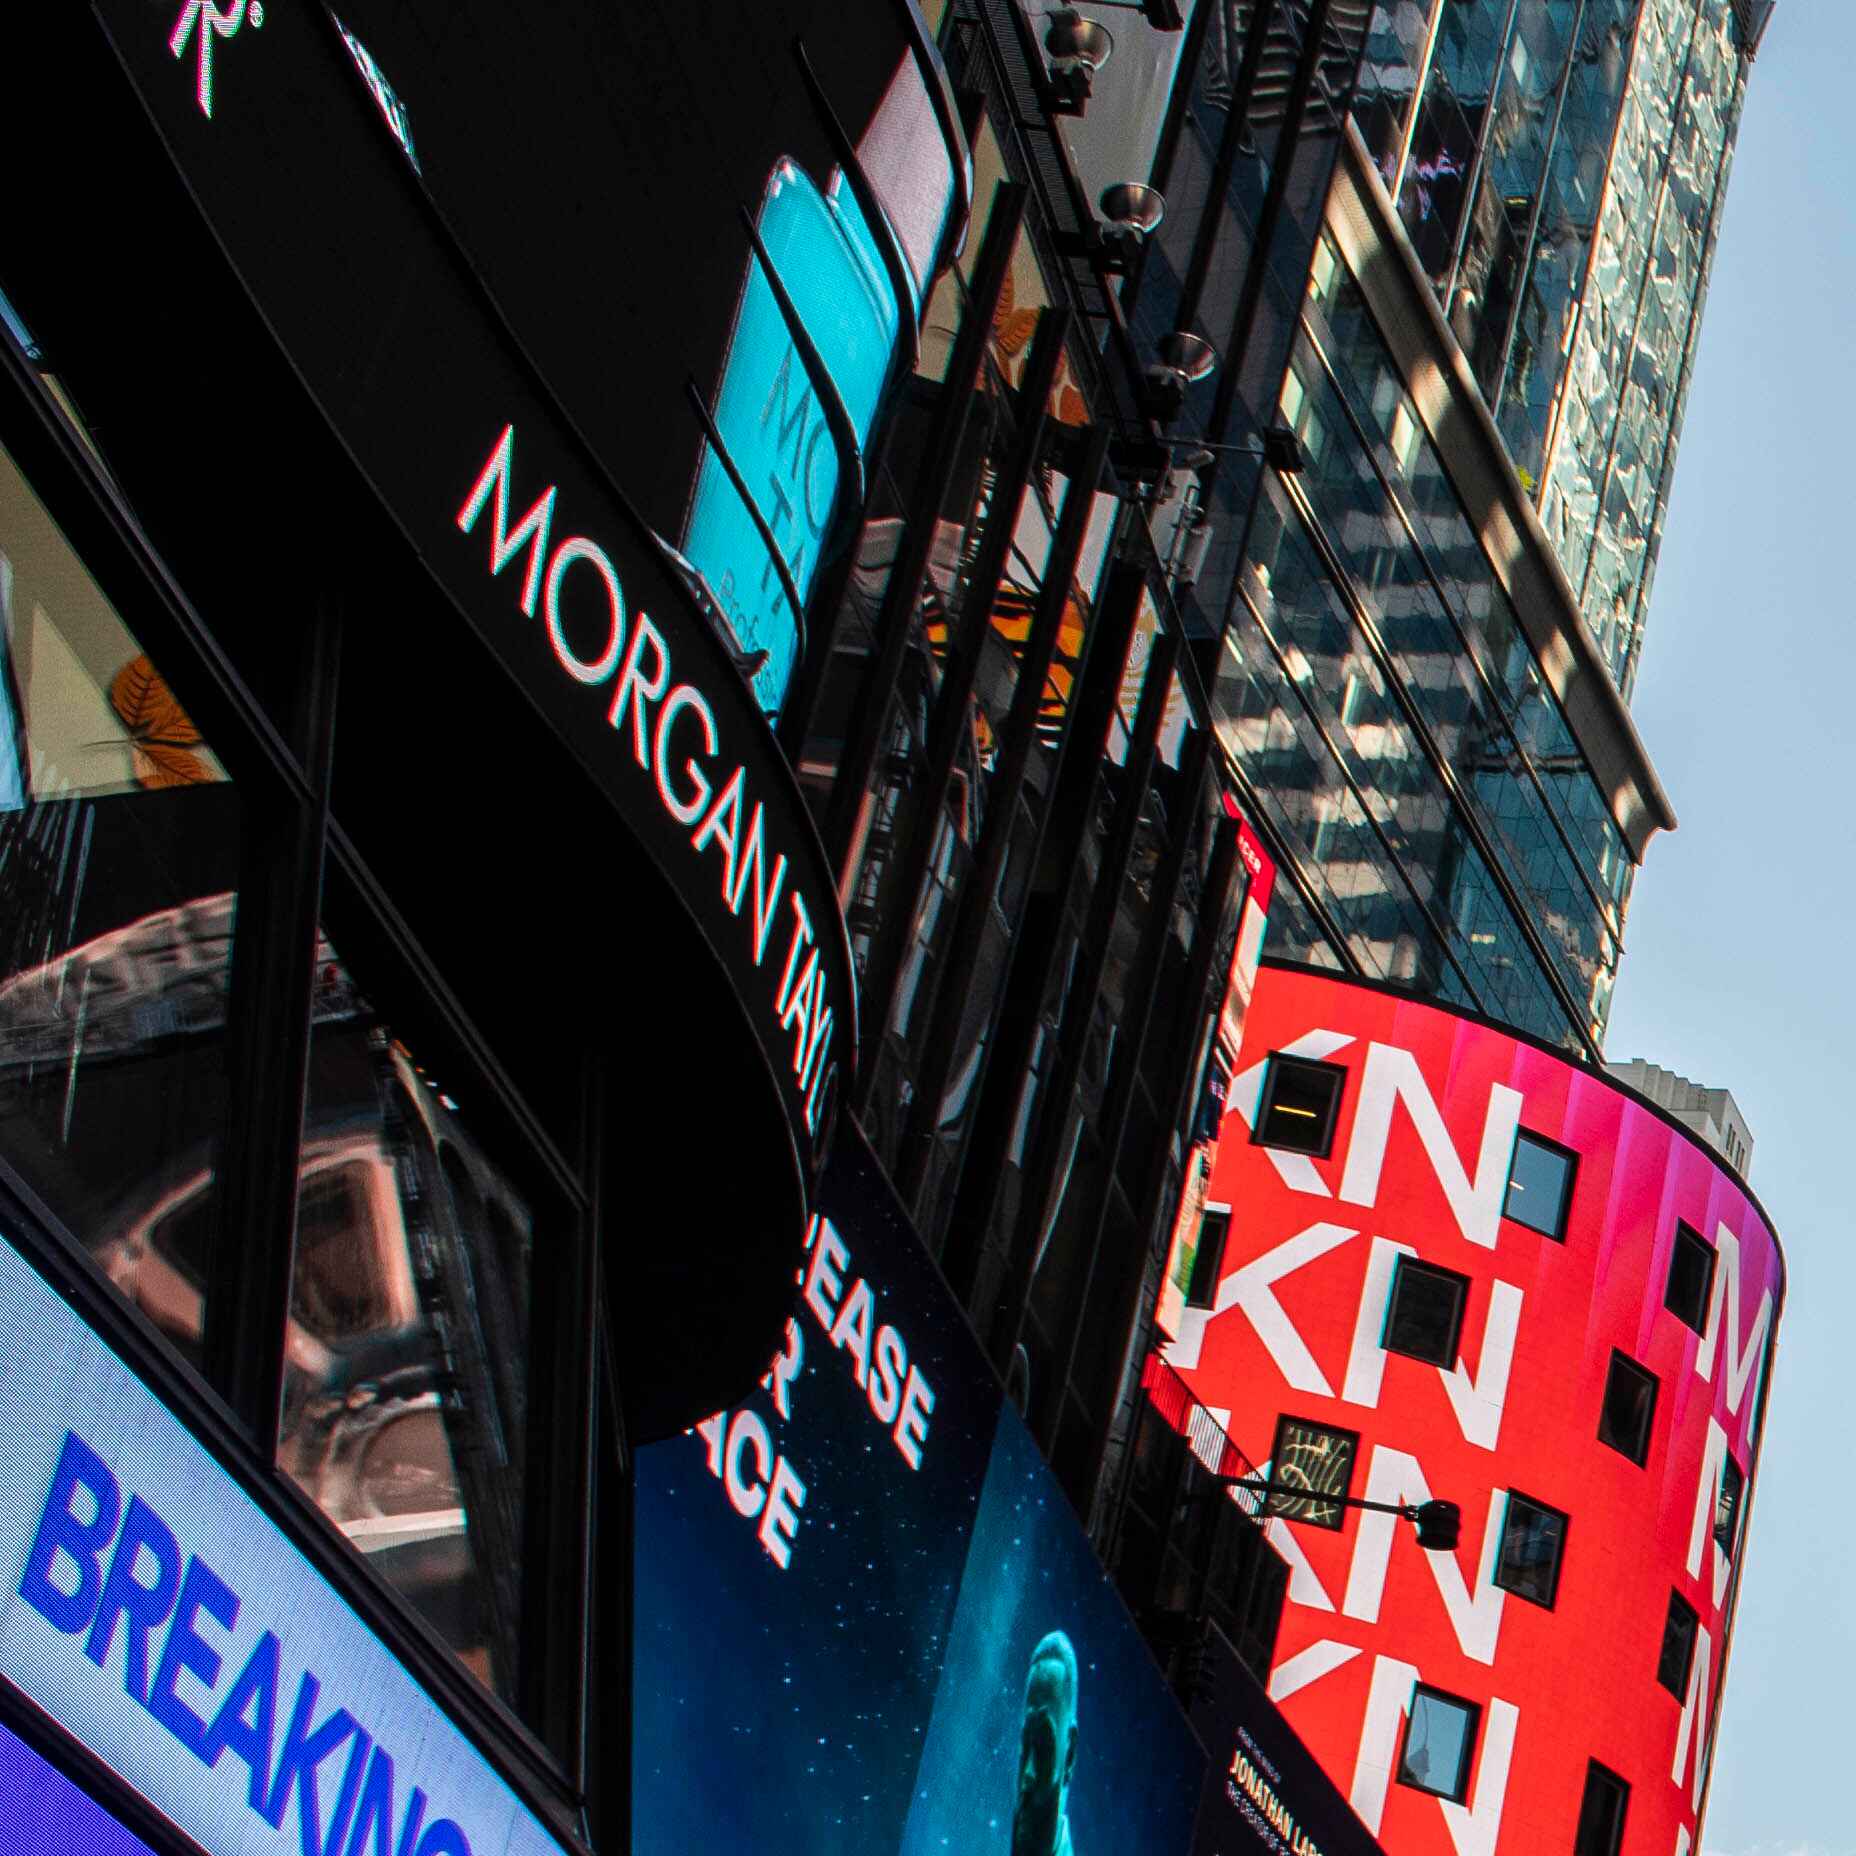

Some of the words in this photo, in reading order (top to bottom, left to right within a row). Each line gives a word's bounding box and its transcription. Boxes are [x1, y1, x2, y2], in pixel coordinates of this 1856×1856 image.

[457, 423, 789, 968] MORGAN
[802, 1212, 936, 1473] EASE
[1229, 1750, 1294, 1841] JONATHAN
